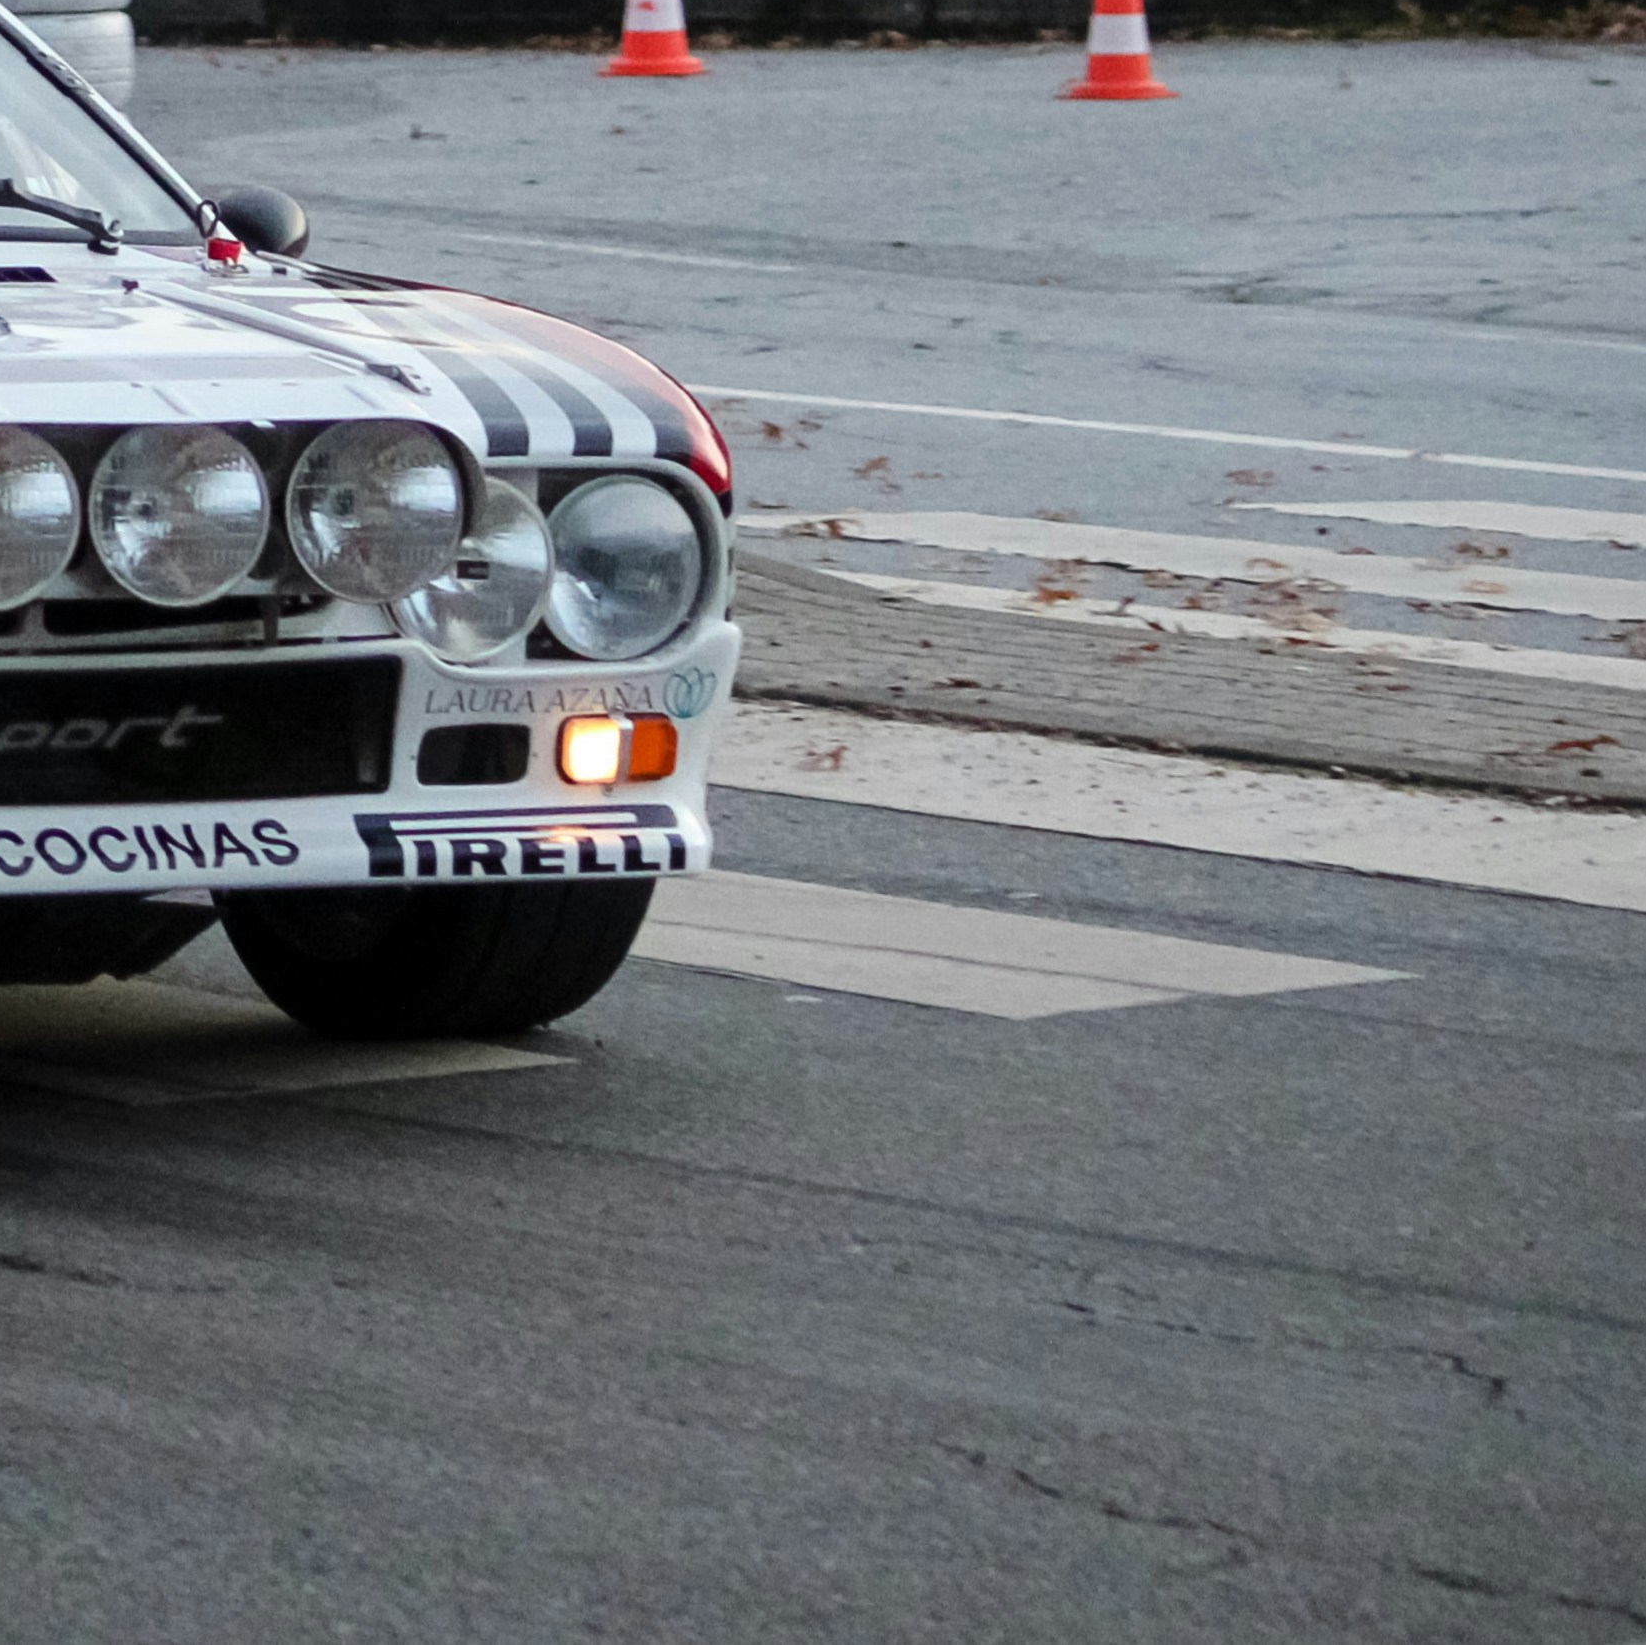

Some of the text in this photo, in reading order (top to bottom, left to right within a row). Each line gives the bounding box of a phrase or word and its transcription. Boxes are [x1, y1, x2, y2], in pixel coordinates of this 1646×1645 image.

[423, 682, 654, 715] LAURA AZAÑA
[353, 804, 688, 877] PIRELLI
